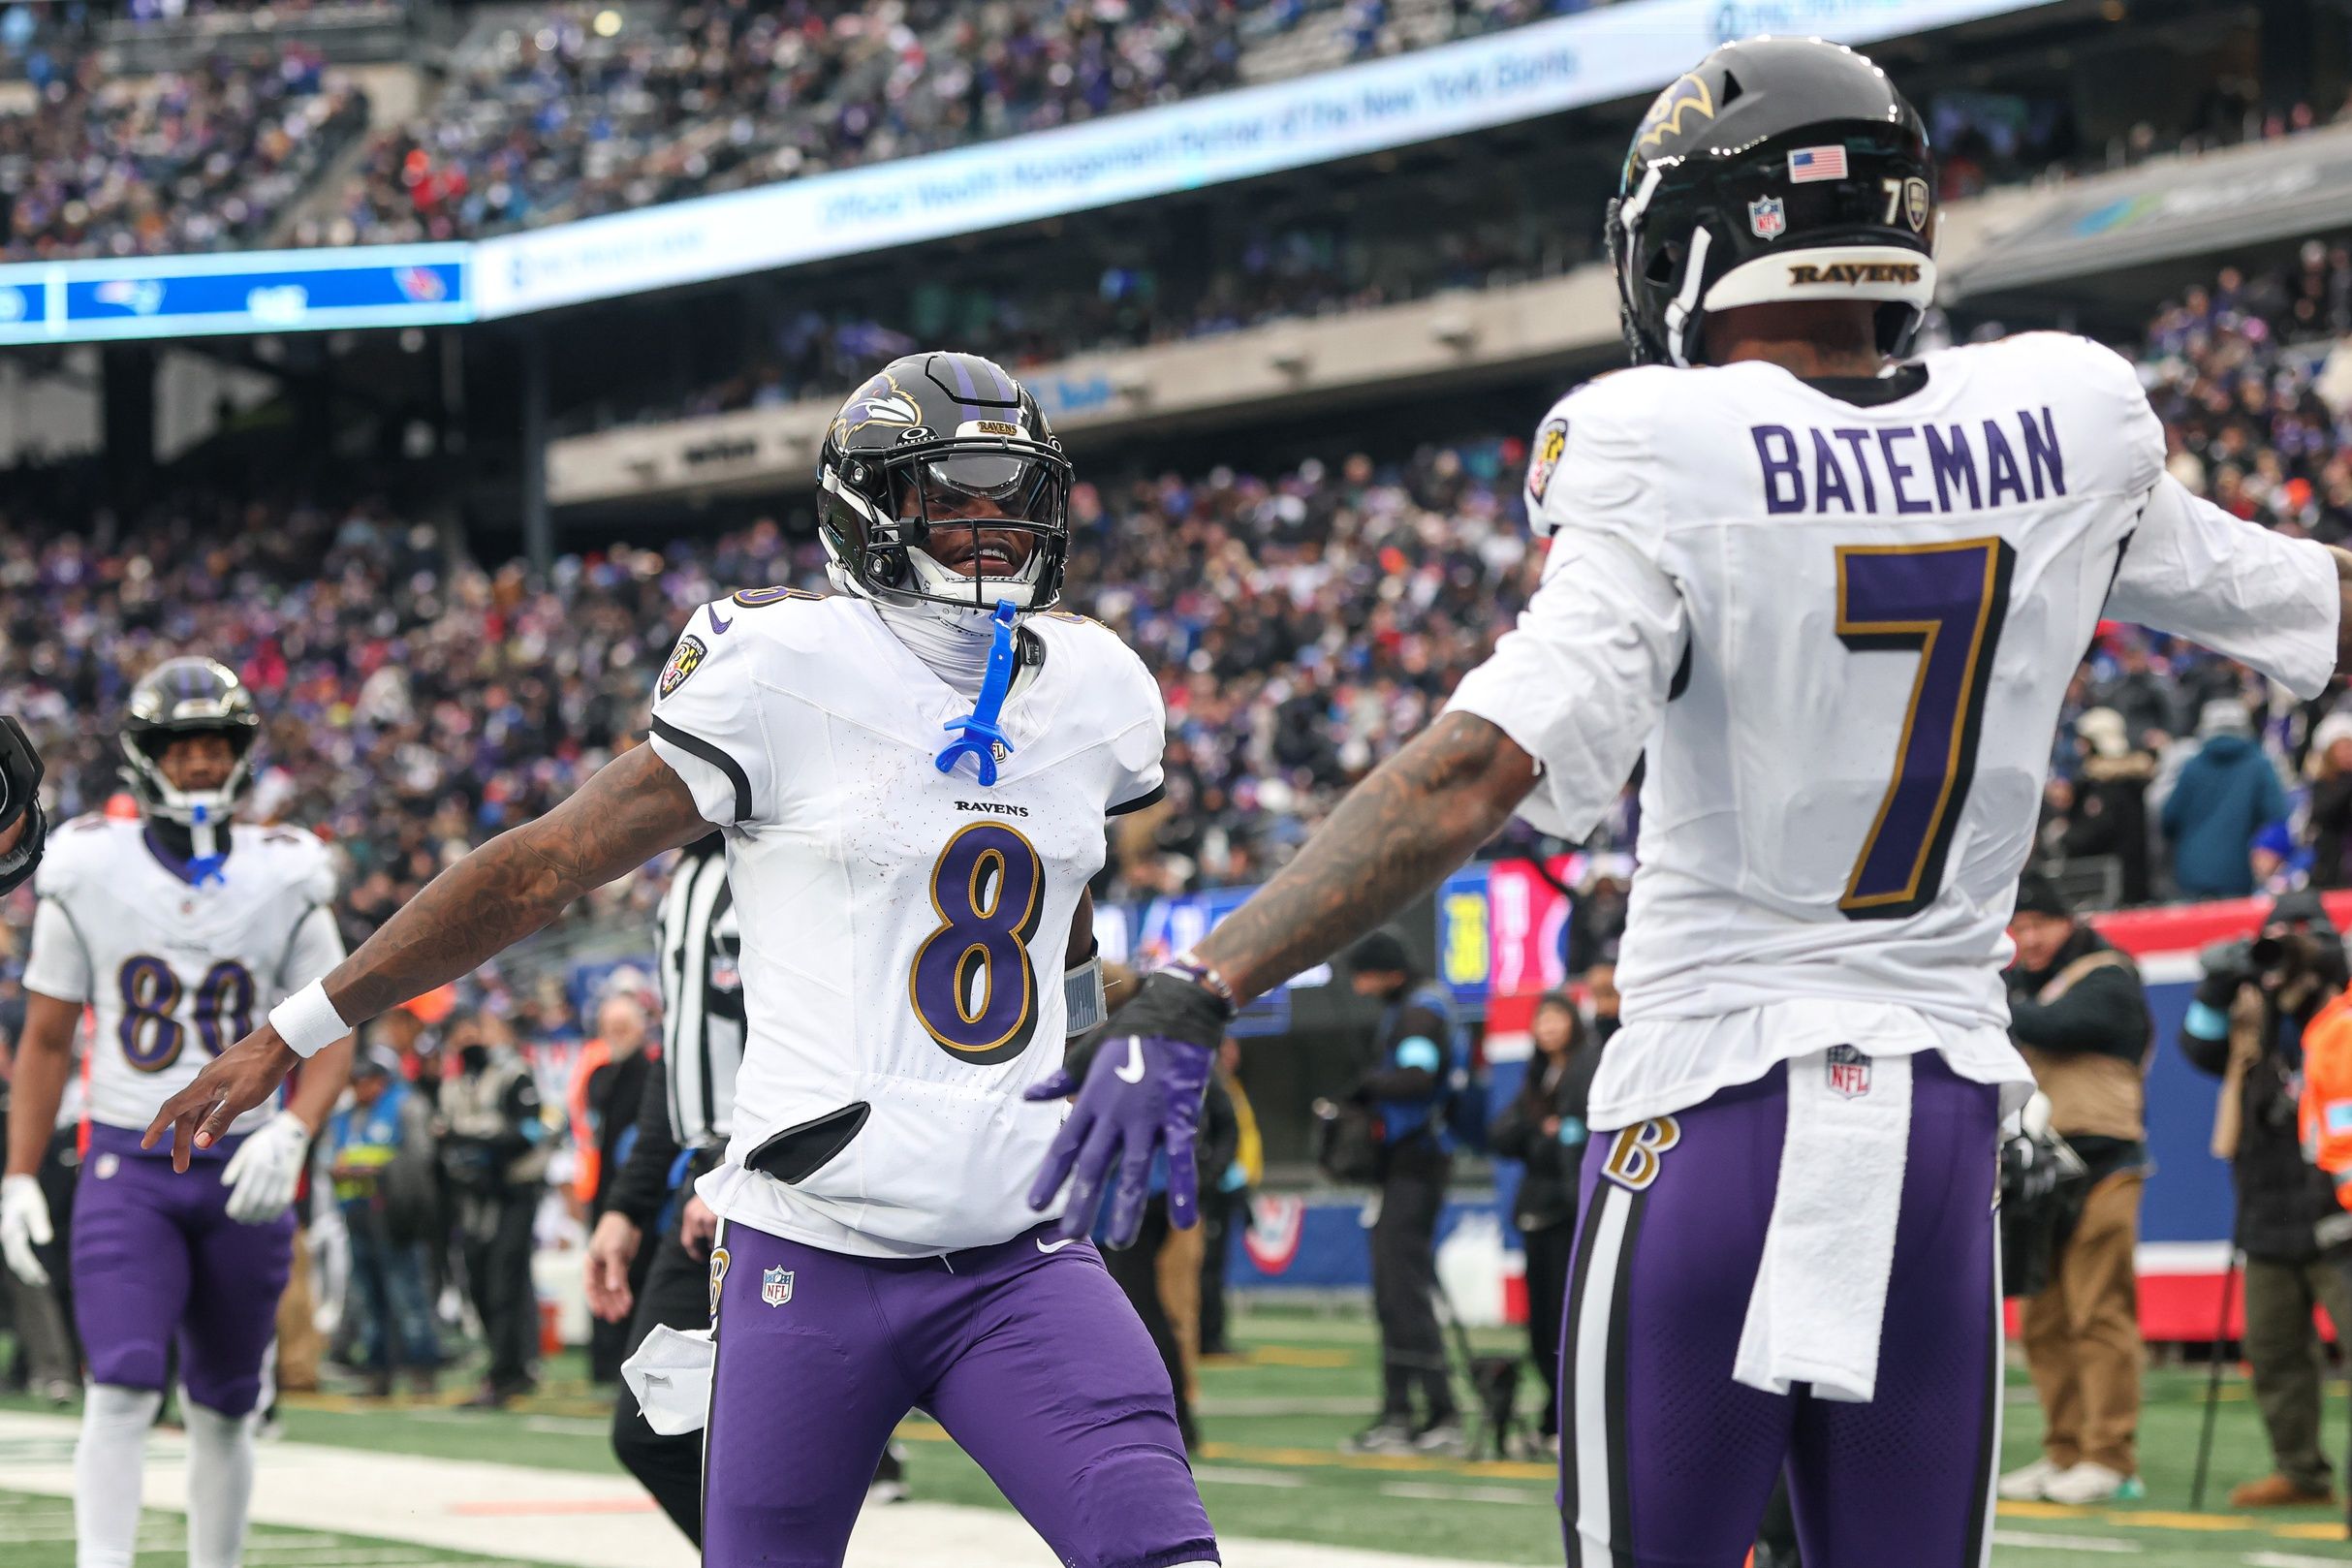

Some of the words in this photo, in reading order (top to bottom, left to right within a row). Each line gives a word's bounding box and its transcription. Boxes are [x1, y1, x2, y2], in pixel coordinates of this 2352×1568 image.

[1883, 177, 1902, 225] 7
[1788, 264, 1921, 286] RAVENS
[978, 421, 1018, 435] RAVENS
[1750, 408, 2066, 515] BATEMAN
[1835, 536, 2017, 921] 7
[955, 801, 1029, 817] RAVENS
[909, 820, 1046, 1065] 8
[118, 953, 255, 1073] 80
[1832, 1063, 1869, 1093] NFL
[1601, 1115, 1680, 1191] B
[767, 1284, 787, 1299] NFL
